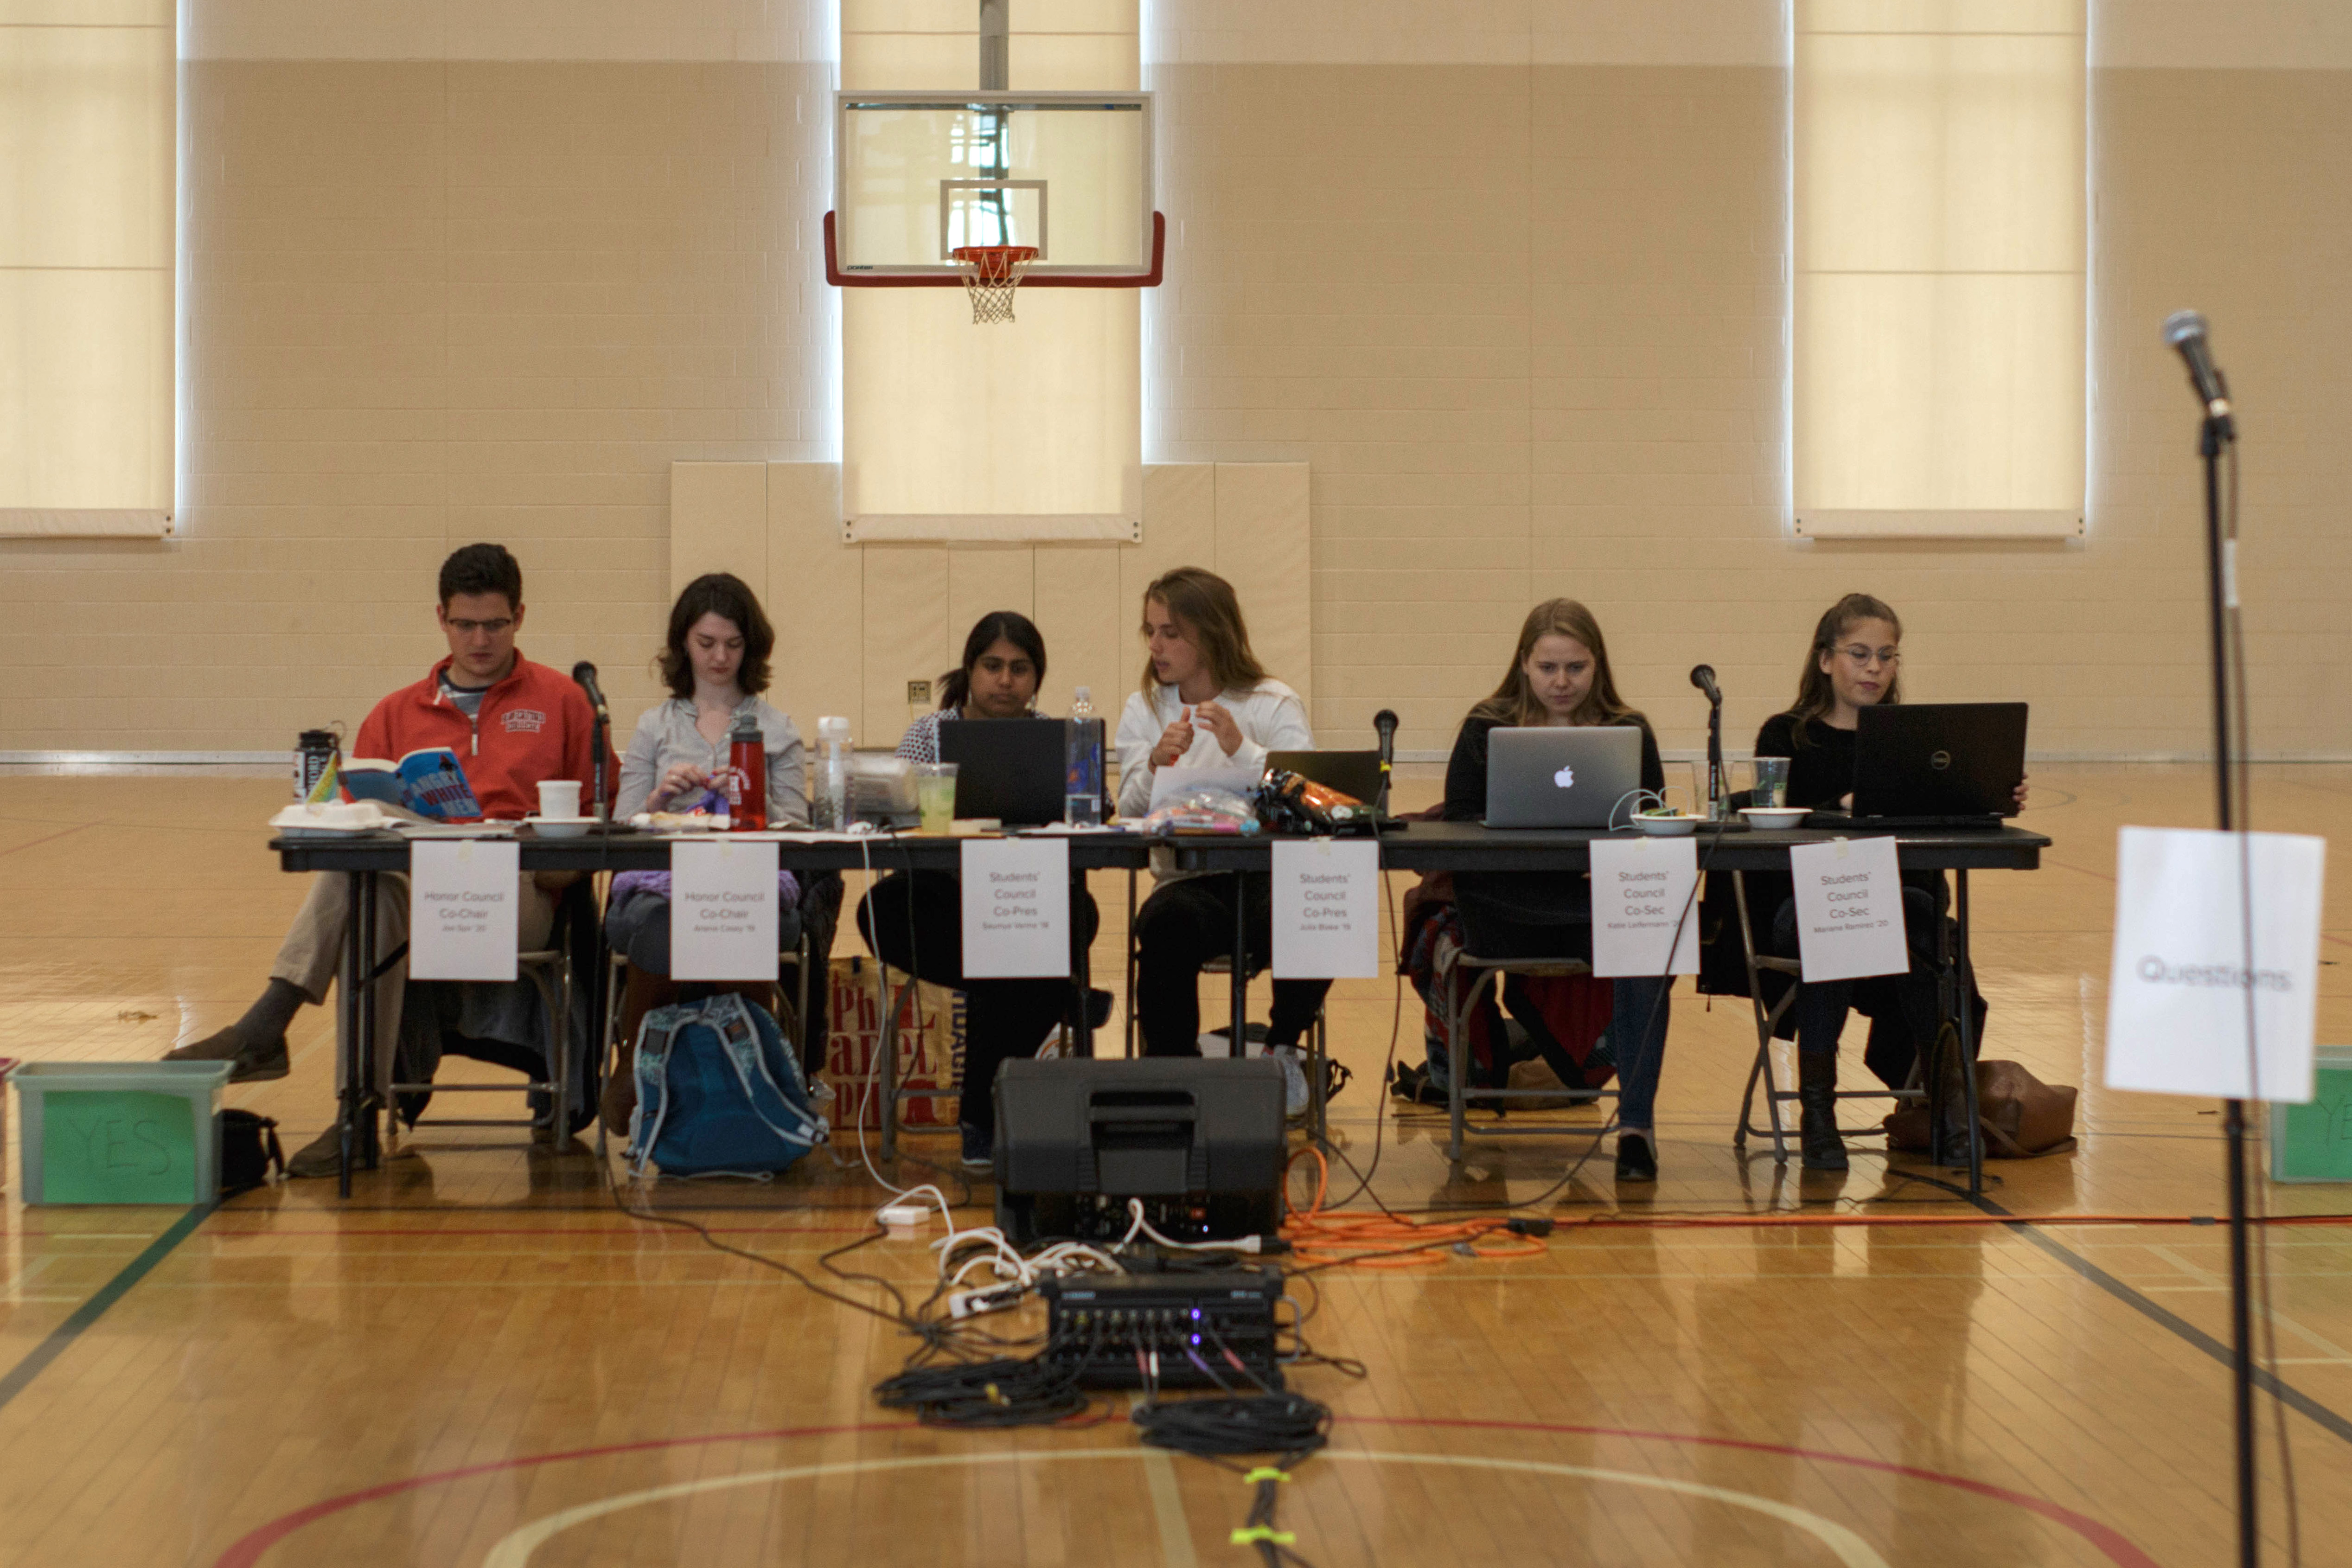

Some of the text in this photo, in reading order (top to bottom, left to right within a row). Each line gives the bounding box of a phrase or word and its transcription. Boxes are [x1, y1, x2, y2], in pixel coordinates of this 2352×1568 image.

[421, 784, 473, 806] WHITE
[425, 890, 505, 902] Honor Council
[684, 890, 765, 902] Honor Council
[994, 889, 1036, 900] Council
[1304, 890, 1346, 901] Council
[1623, 888, 1665, 899] Council
[1827, 889, 1868, 902] Council
[439, 908, 488, 919] Co-Chair
[699, 908, 748, 919] Co-Chair
[993, 906, 1038, 916] Co-Pres
[1303, 907, 1347, 918] Co-Pres
[1625, 905, 1664, 915] Co-Sec
[1829, 907, 1870, 919] Co-Sec
[2136, 954, 2294, 992] Questions
[68, 1119, 171, 1176] YES
